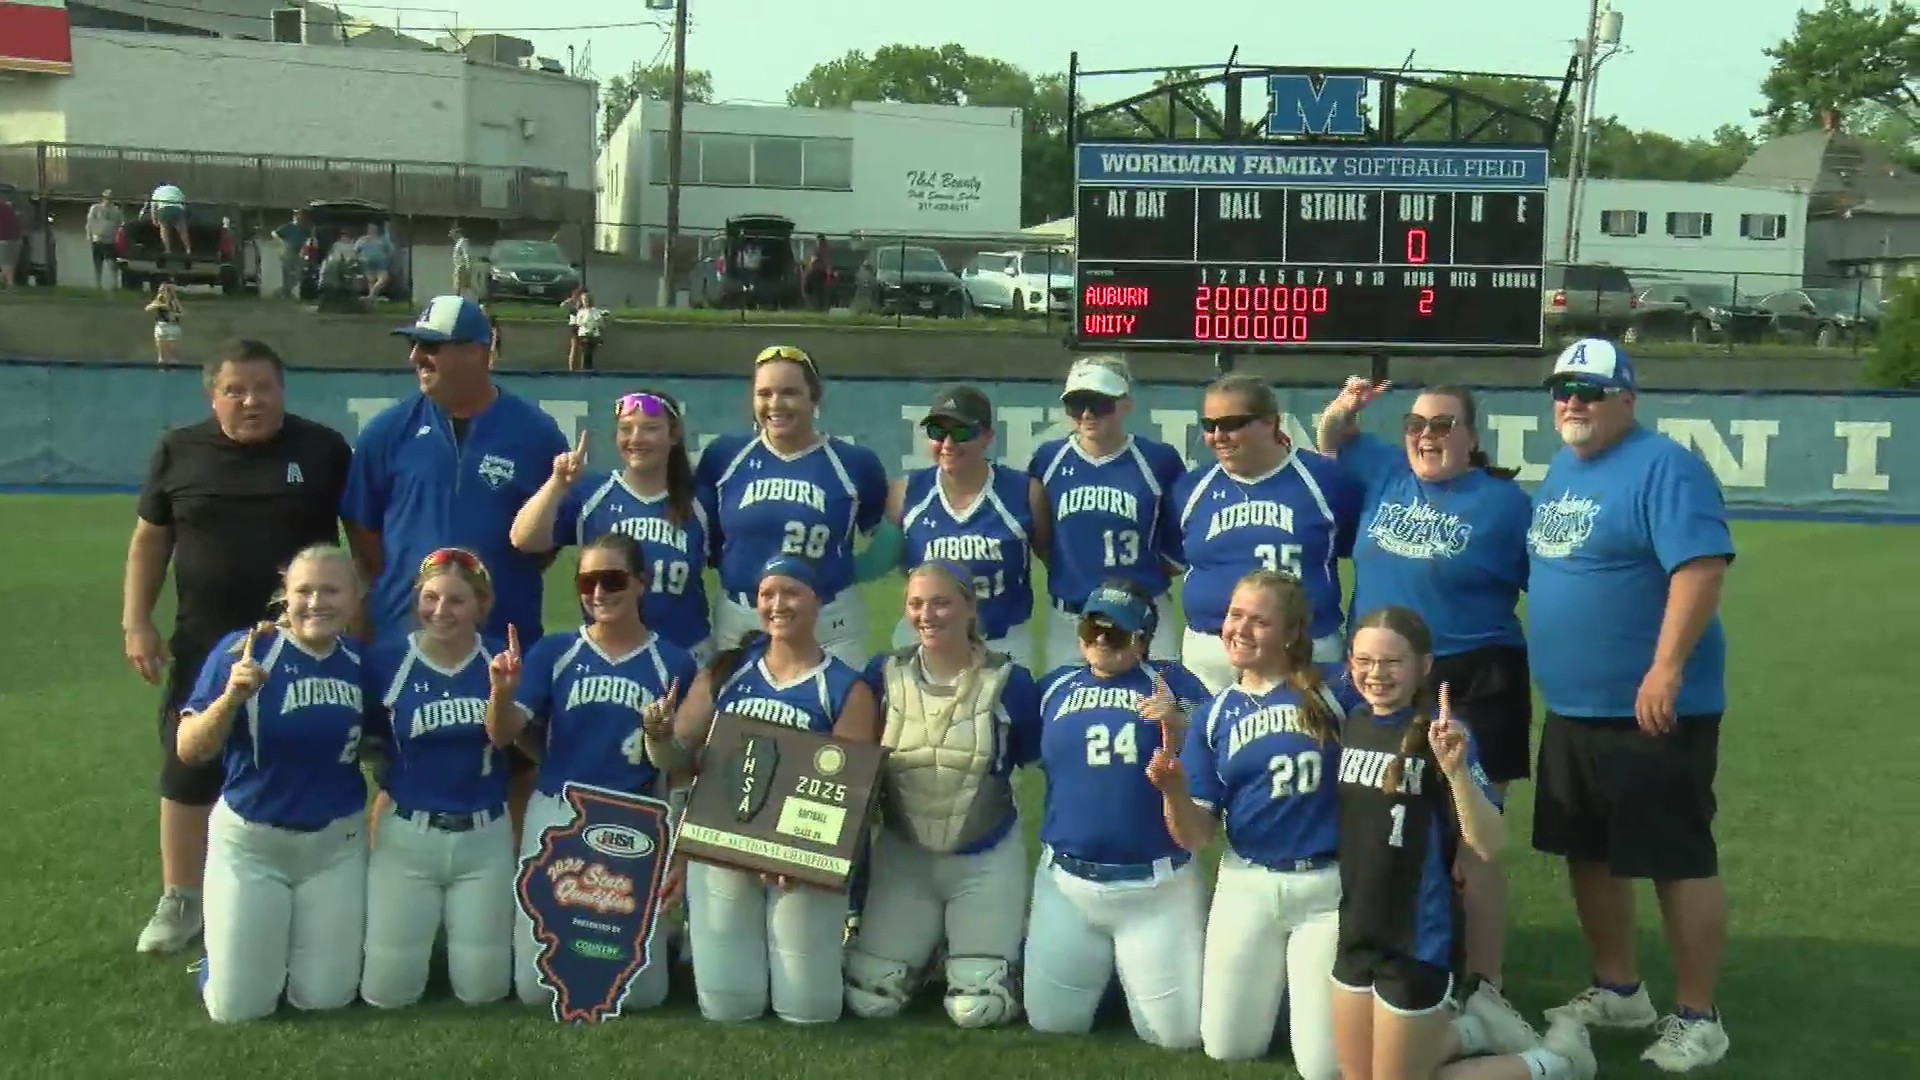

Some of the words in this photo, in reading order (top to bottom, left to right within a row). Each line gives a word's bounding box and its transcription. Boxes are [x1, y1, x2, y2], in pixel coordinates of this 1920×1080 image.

[1268, 74, 1366, 135] M
[1101, 153, 1237, 175] WORKMAN
[1243, 155, 1338, 176] FAMILY
[1344, 157, 1458, 178] SOFTBALL
[1464, 159, 1527, 178] FIELD
[941, 172, 981, 193] Beauty
[1107, 190, 1128, 217] AT
[1135, 191, 1168, 218] BAT
[1219, 192, 1262, 219] BALL
[1300, 193, 1368, 222] STRIKE
[1400, 194, 1437, 222] OUT
[1471, 195, 1484, 223] H
[1517, 195, 1527, 224] E
[1407, 230, 1426, 263] 0
[1201, 269, 1207, 285] 1
[1219, 269, 1228, 285] 2
[1238, 269, 1247, 285] 3
[1258, 269, 1266, 285] 4
[1277, 270, 1286, 285] 5
[1296, 270, 1305, 285] 6
[1316, 270, 1324, 285] 7
[1336, 271, 1343, 286] 8
[1355, 271, 1363, 286] 9
[1372, 271, 1385, 286] 10
[1403, 272, 1435, 287] RUNS
[1450, 272, 1477, 288] HITS
[1491, 273, 1536, 289] ERRORS
[1085, 286, 1149, 307] AUBURN
[1418, 289, 1434, 313] 2
[1084, 314, 1135, 334] UNITY
[1567, 344, 1588, 365] A
[738, 477, 826, 513] AUBURN
[1057, 485, 1138, 522] AUBURN
[1205, 500, 1294, 543] AUBURN
[781, 520, 831, 559] 28
[1103, 530, 1140, 567] 13
[651, 560, 690, 595] 19
[410, 698, 488, 739] AUBUR
[1228, 704, 1306, 762] AUBUR
[339, 725, 362, 764] 2
[621, 727, 644, 765] 4
[1085, 723, 1138, 766] 24
[738, 739, 756, 813] IHSA
[795, 776, 847, 801] 2025
[1269, 751, 1322, 799] 20
[1388, 804, 1407, 848] 1
